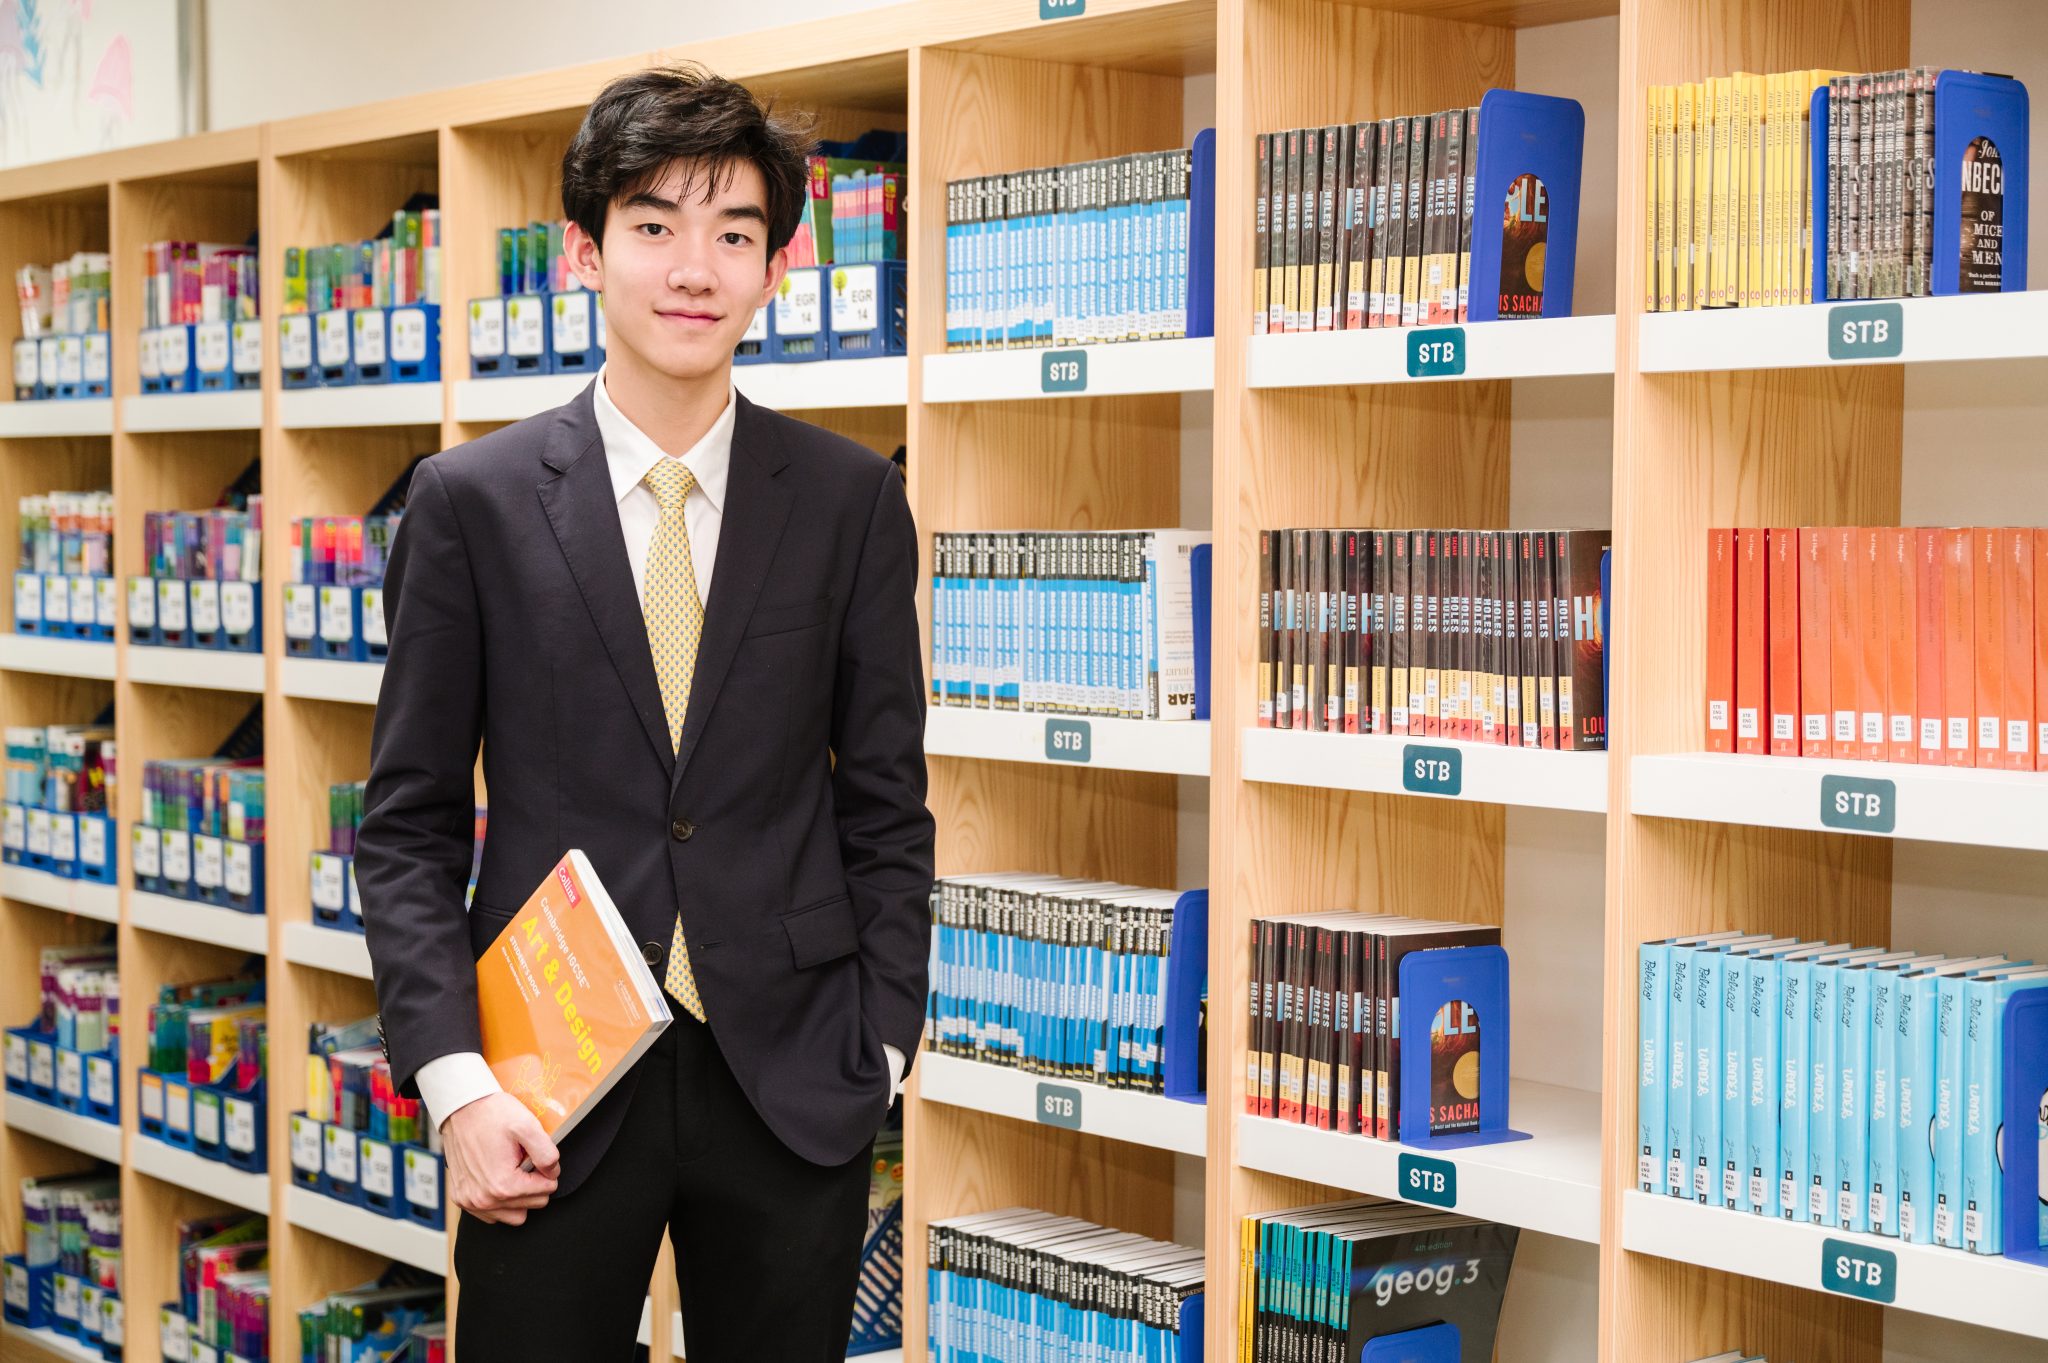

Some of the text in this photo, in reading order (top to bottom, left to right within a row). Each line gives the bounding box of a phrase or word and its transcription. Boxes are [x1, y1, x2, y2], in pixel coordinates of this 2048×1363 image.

[1829, 126, 1837, 166] STEINBECK
[1841, 126, 1849, 166] STEINBECK
[1874, 123, 1883, 163] STEINBECK
[1180, 155, 1186, 168] NO
[1829, 170, 1835, 181] OF
[1842, 171, 1848, 182] OF
[1875, 167, 1881, 179] OF
[1288, 193, 1297, 230] HOLES
[1304, 192, 1314, 230] HOLES
[1322, 191, 1332, 227] HOLES
[1354, 188, 1364, 225] HOLES
[1376, 185, 1386, 225] HOLES
[1392, 183, 1402, 220] HOLES
[1410, 182, 1420, 220] HOLES
[1434, 178, 1445, 216] HOLES
[1447, 178, 1457, 216] HOLES
[1465, 176, 1475, 214] HOLES
[1257, 197, 1266, 233] HOLES
[1273, 194, 1282, 233] HOLES
[1973, 223, 2003, 238] MICE
[1980, 210, 1995, 222] OF
[1971, 250, 2002, 265] MEN
[1977, 239, 1998, 249] AND
[795, 293, 816, 307] EGR
[852, 289, 872, 303] EGR
[858, 308, 868, 320] 14
[802, 312, 812, 323] 14
[1842, 319, 1889, 344] STB
[1419, 341, 1454, 363] STB
[1050, 361, 1079, 381] STB
[1134, 538, 1140, 553] NO
[1261, 593, 1269, 628] HOLES
[1348, 595, 1356, 631] HOLES
[1375, 594, 1384, 631] HOLES
[1395, 596, 1405, 632] HOLES
[1413, 595, 1423, 631] HOLES
[1428, 596, 1437, 633] HOLES
[1451, 596, 1459, 633] HOLES
[1461, 597, 1469, 633] HOLES
[1474, 597, 1482, 634] HOLES
[1483, 599, 1492, 636] HOLES
[1494, 599, 1502, 637] HOLES
[1507, 601, 1515, 638] HOLES
[1523, 600, 1532, 638] HOLES
[1539, 600, 1549, 638] HOLES
[1559, 599, 1568, 638] HOLES
[1574, 595, 1599, 641] H
[1053, 730, 1082, 751] STB
[1415, 758, 1450, 781] STB
[1835, 790, 1881, 817] STB
[558, 866, 577, 904] Collins
[540, 896, 569, 955] Cambridge
[520, 915, 603, 1076] Art & Design
[527, 974, 541, 998] BOOK
[1250, 981, 1258, 1017] HOLES
[1264, 983, 1272, 1018] HOLES
[1284, 984, 1292, 1019] HOLES
[1295, 987, 1304, 1023] HOLES
[1312, 990, 1321, 1025] HOLES
[1322, 992, 1330, 1028] HOLES
[1363, 998, 1371, 1034] HOLES
[1378, 999, 1386, 1035] HOLES
[1045, 1095, 1073, 1117] STB
[1439, 1102, 1479, 1122] SACHA
[1409, 1168, 1445, 1193] STB
[1414, 1241, 1453, 1252] 4th edition
[1375, 1258, 1481, 1307] geog.3
[1836, 1255, 1882, 1286] STB
